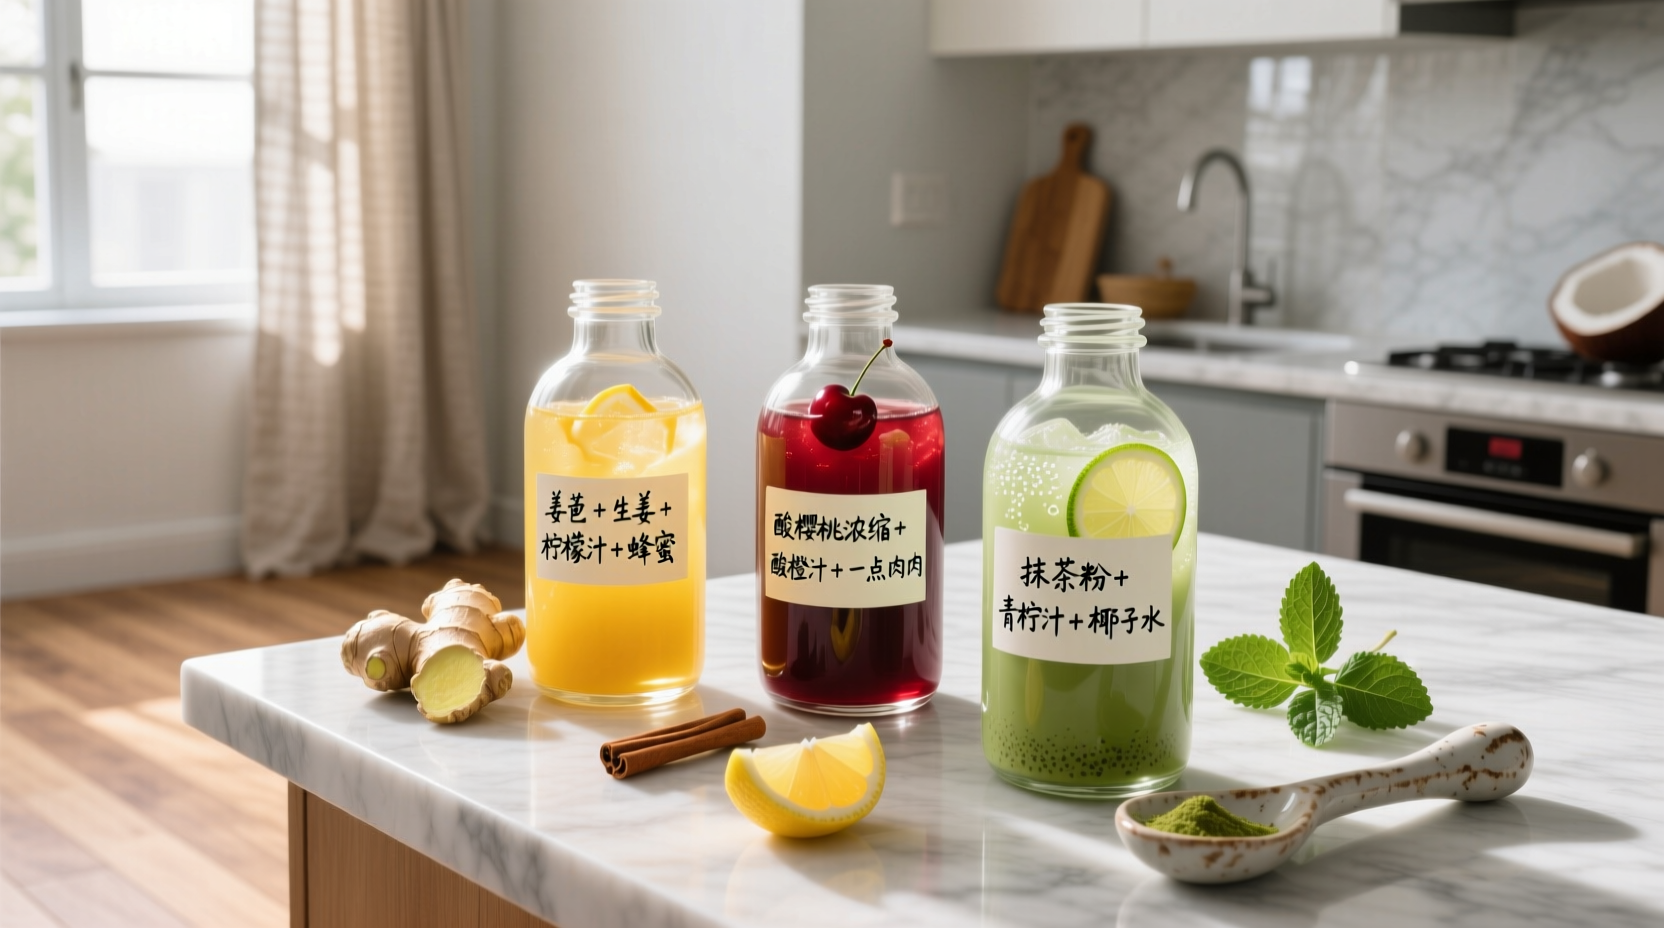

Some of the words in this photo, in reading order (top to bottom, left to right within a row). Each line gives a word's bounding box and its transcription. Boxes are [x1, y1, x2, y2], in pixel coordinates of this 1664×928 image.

[541, 529, 676, 566] 柠檬汁+蜂蜜
[1019, 556, 1129, 593] 抹茶粉+
[998, 594, 1165, 640] 青柠汁+椰子水
